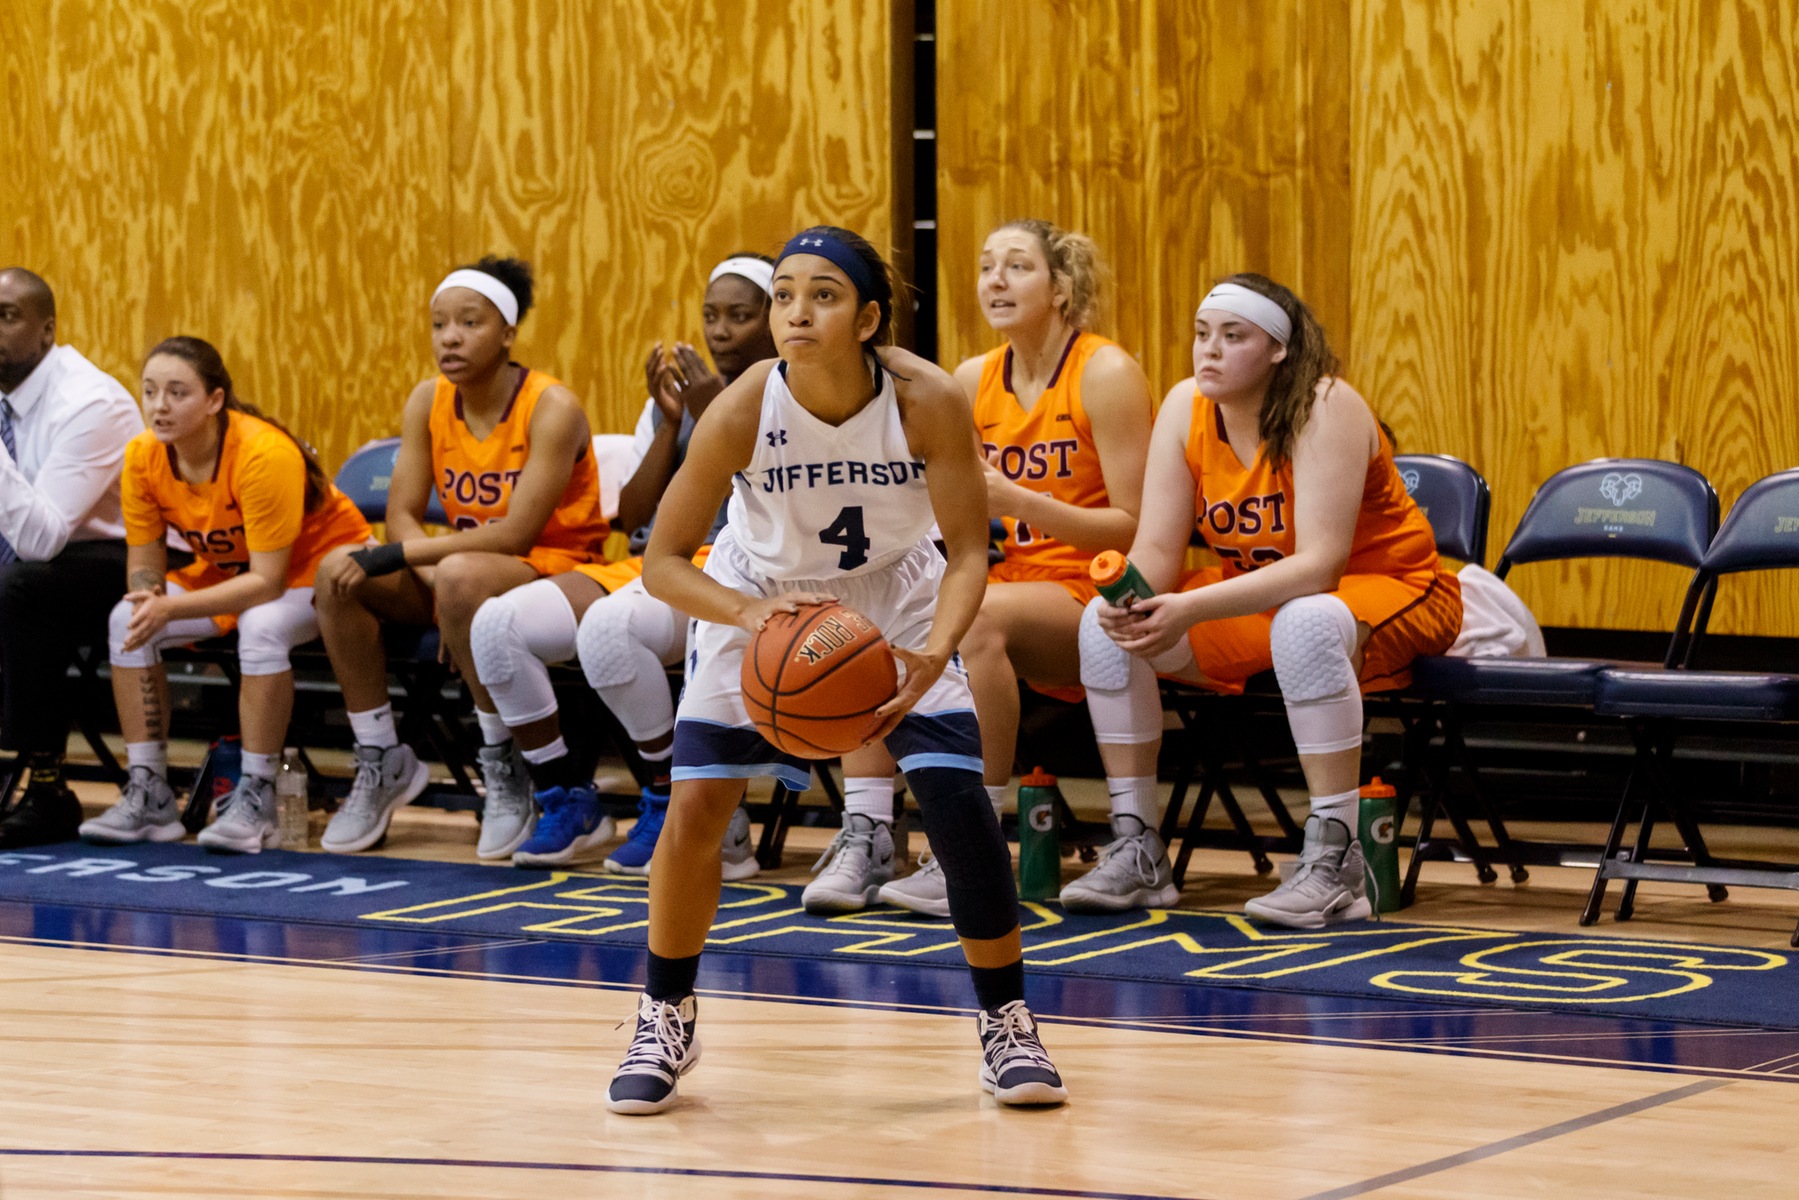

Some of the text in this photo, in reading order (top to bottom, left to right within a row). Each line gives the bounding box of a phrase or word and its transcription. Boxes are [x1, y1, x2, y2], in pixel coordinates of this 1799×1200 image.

[1197, 491, 1285, 534] OST
[818, 505, 870, 571] 4
[1029, 804, 1052, 831] G
[1370, 815, 1393, 844] G
